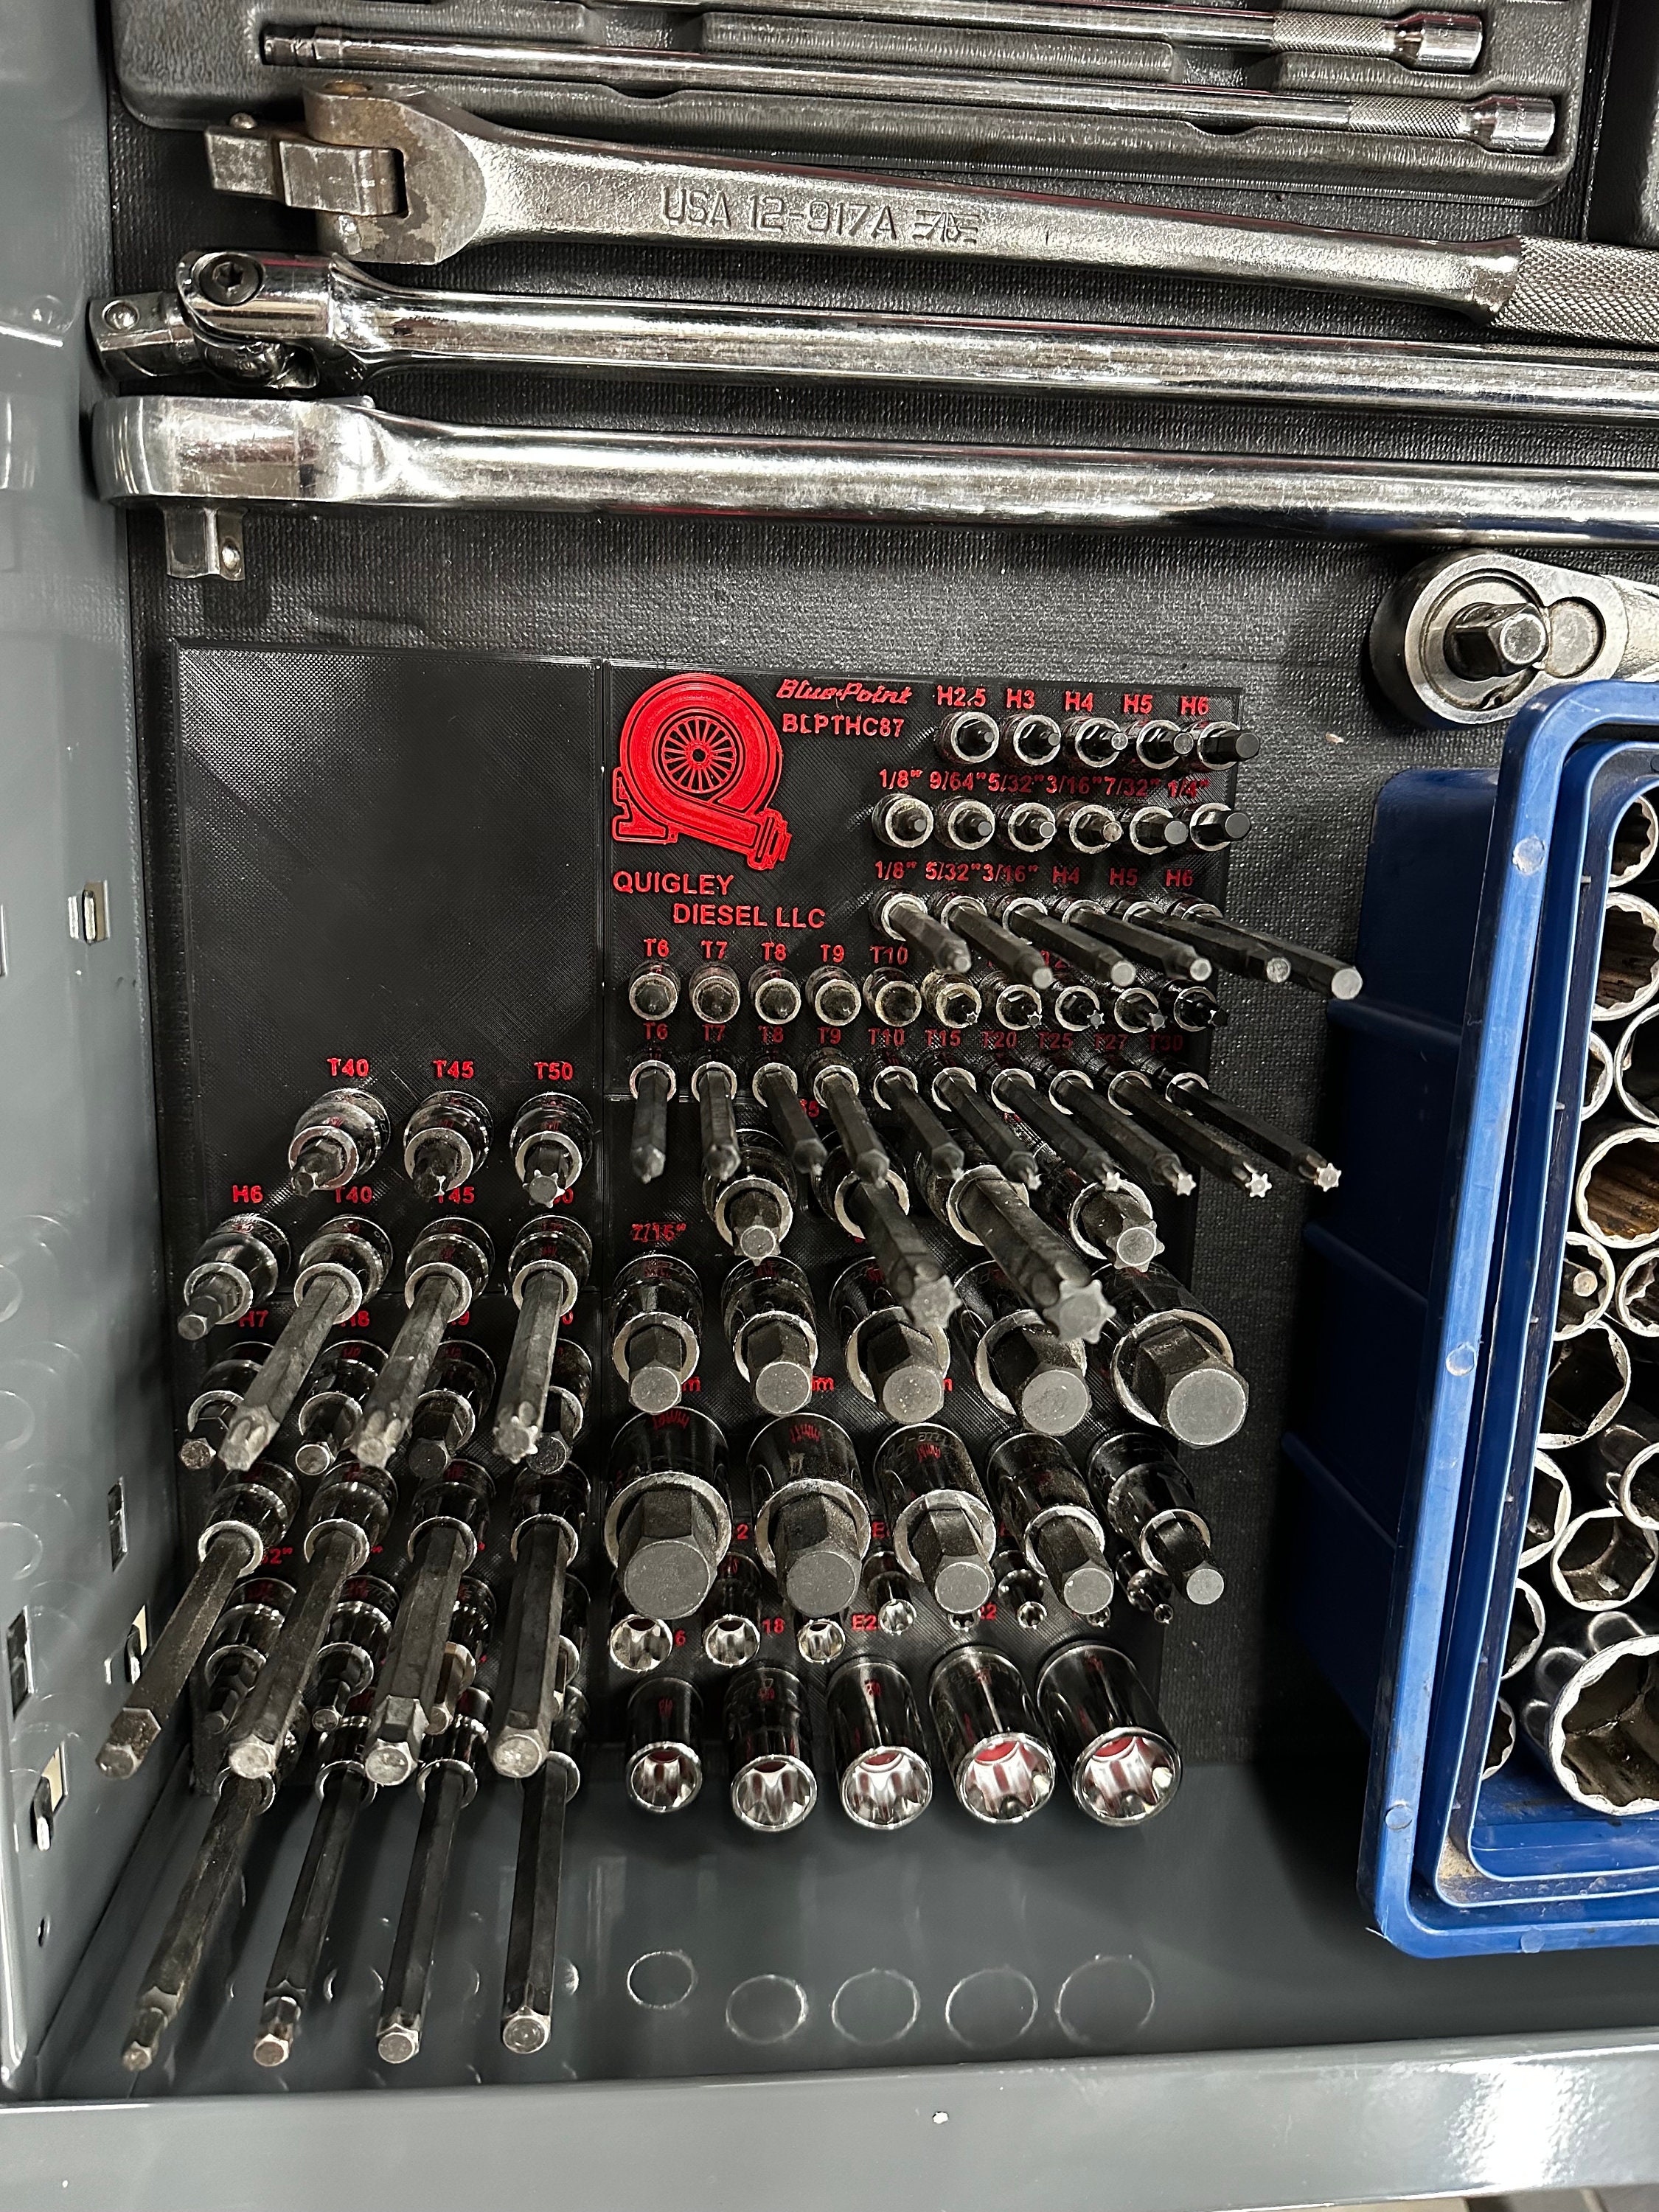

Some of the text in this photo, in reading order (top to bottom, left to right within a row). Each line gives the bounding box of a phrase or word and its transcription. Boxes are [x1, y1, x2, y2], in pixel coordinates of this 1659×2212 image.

[663, 188, 731, 230] USA
[747, 194, 898, 241] 12-917A
[936, 684, 1211, 717] H2.5 H3 H4 H5 H6
[782, 712, 905, 738] BLPTHC87
[879, 768, 924, 790] 1/8"
[929, 771, 987, 791] 9/64"
[987, 771, 1044, 793] 5/32"
[612, 870, 735, 897] QUIGLEY
[1051, 866, 1079, 885] H4
[1109, 868, 1138, 886] H5
[1165, 869, 1193, 887] H6
[673, 902, 827, 929] DIESEL LLC
[643, 938, 909, 965] T6 T7 T8 T9 T10
[643, 1021, 668, 1040] T6
[703, 1023, 726, 1042] T7
[758, 1026, 784, 1044] T8
[817, 1026, 842, 1045] T9
[868, 1027, 905, 1047] T10
[925, 1029, 961, 1048] T15
[983, 1031, 1018, 1049] T20
[1038, 1032, 1074, 1050] T25
[327, 1057, 574, 1081] T40 T45 T50
[232, 1183, 265, 1203] H6
